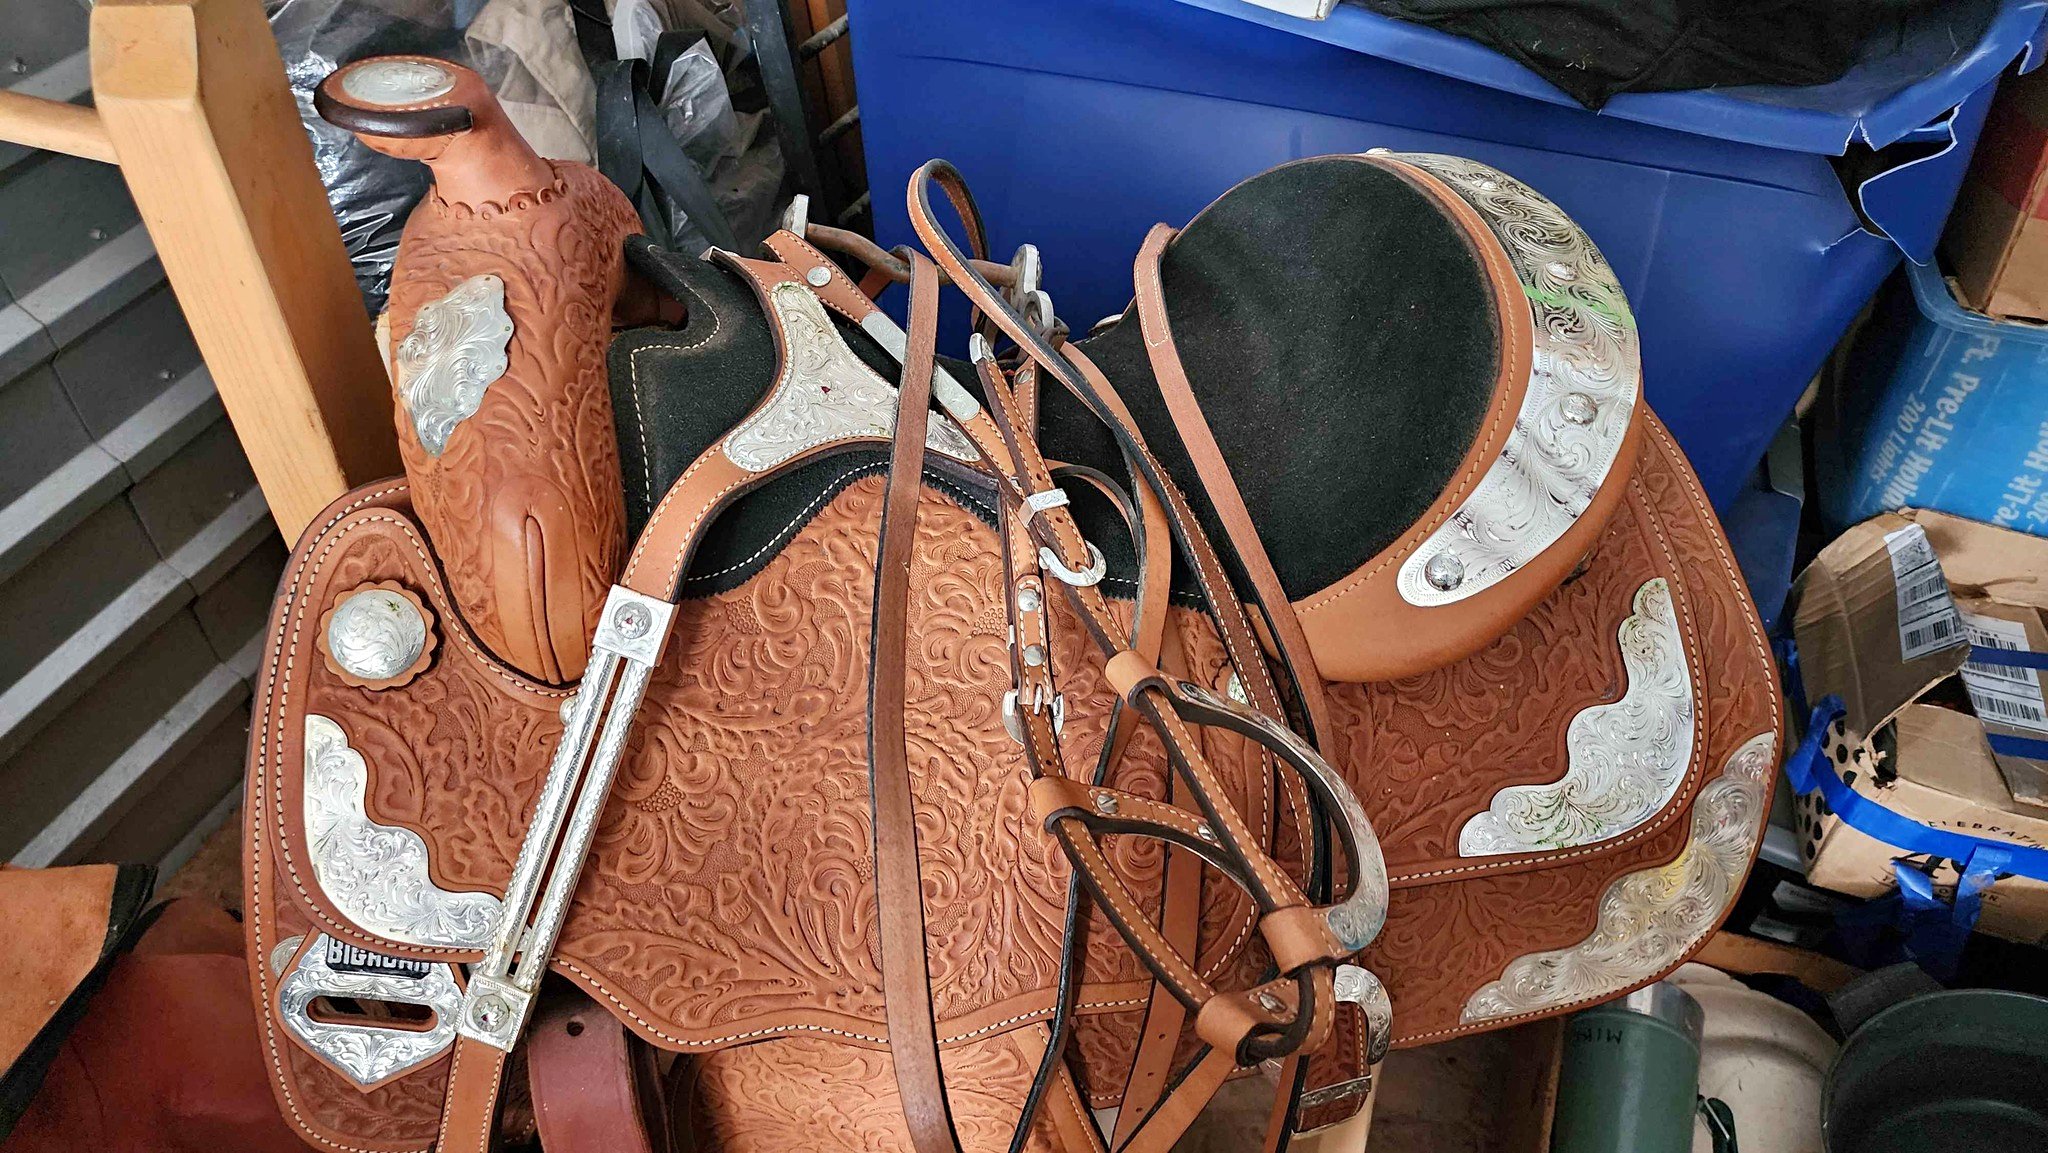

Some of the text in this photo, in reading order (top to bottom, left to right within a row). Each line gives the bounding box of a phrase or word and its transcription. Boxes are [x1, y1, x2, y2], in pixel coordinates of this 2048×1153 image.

[1898, 392, 1926, 433] 200
[1915, 372, 1980, 452] Pre-Lit
[1992, 474, 2042, 528] re-Lit
